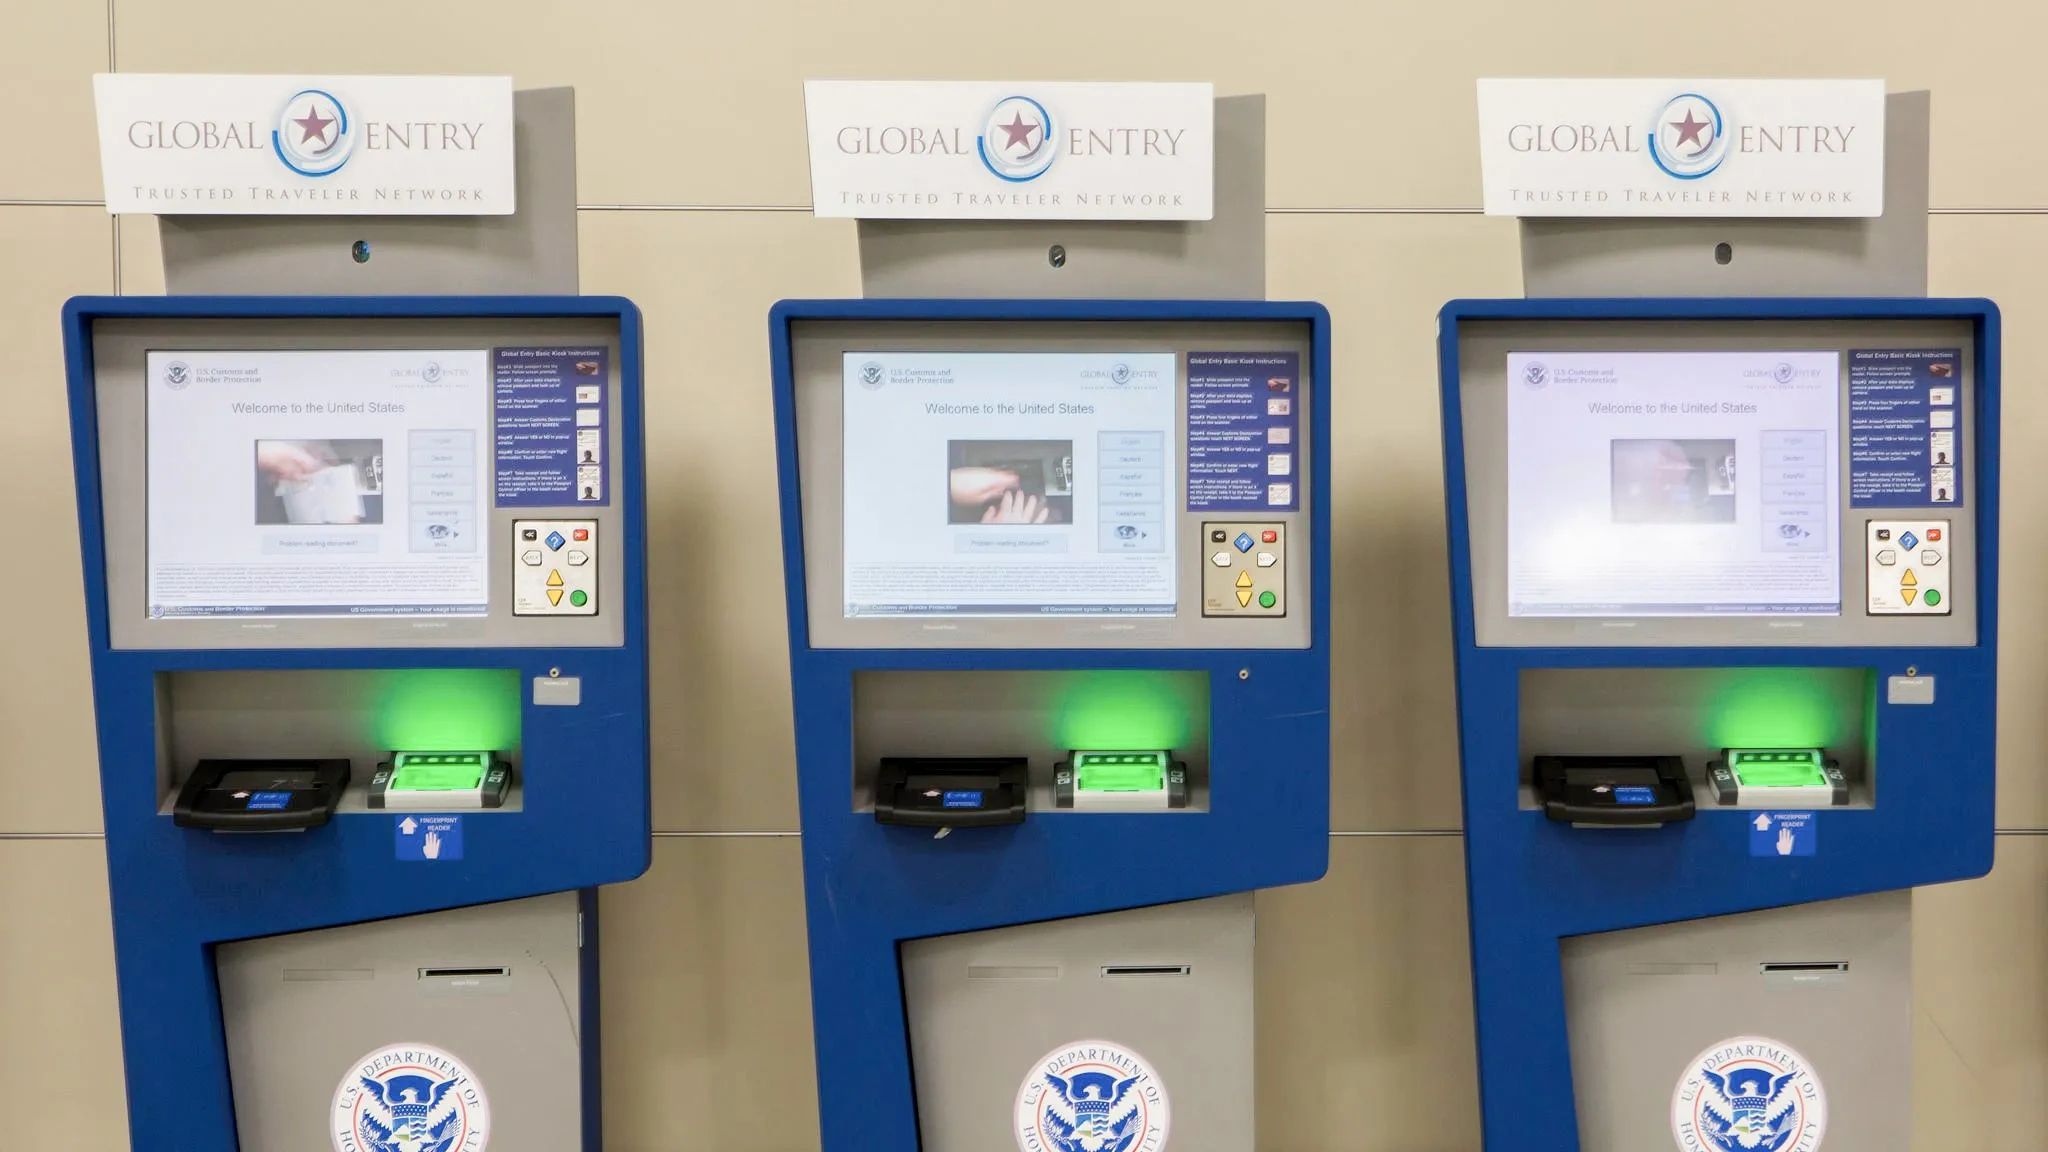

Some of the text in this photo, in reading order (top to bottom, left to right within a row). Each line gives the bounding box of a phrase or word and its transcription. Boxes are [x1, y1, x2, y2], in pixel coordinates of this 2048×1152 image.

[128, 120, 484, 151] GLOBAL ENTRY
[837, 127, 1186, 156] GLOBAL ENTRY
[1508, 124, 1856, 153] GLOBAL ENTRY
[232, 402, 405, 414] Welcome to the United States
[925, 402, 1094, 414] Welcome to the United States
[1588, 402, 1757, 414] Welcome to the United States
[340, 1051, 480, 1110] U.S. DEPARTMENT OF
[1024, 1048, 1161, 1106] U.S. DEPARTMENT OF
[1682, 1044, 1817, 1102] U.S. DEPARTMENT OF
